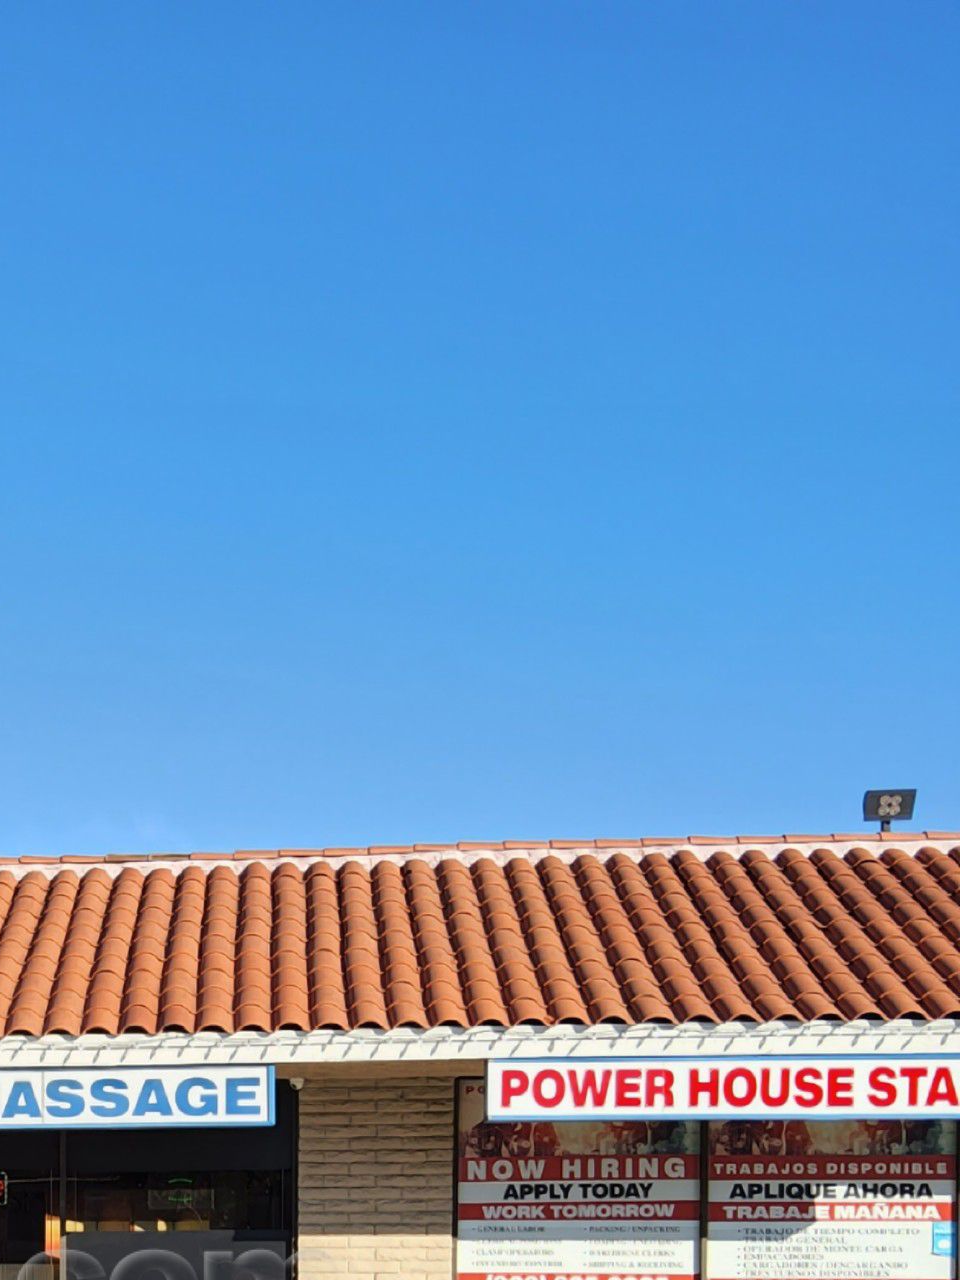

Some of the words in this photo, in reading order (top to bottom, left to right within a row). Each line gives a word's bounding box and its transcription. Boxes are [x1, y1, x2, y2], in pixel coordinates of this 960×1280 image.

[501, 1069, 674, 1108] POWER
[690, 1067, 854, 1107] HOUSE
[868, 1067, 959, 1107] STA
[467, 1159, 545, 1180] NOW
[562, 1157, 686, 1179] HIRING
[714, 1162, 818, 1175] TRABAJOS
[826, 1162, 948, 1175] DISPONIBLE
[503, 1183, 571, 1200] APPLY
[579, 1182, 653, 1199] TODAY
[729, 1182, 837, 1200] APLIQUE
[843, 1182, 933, 1199] AHORA
[482, 1204, 545, 1219] WORK
[550, 1203, 675, 1218] TOMORROW
[722, 1205, 830, 1219] TRABAJE
[834, 1202, 941, 1219] MAÑANA
